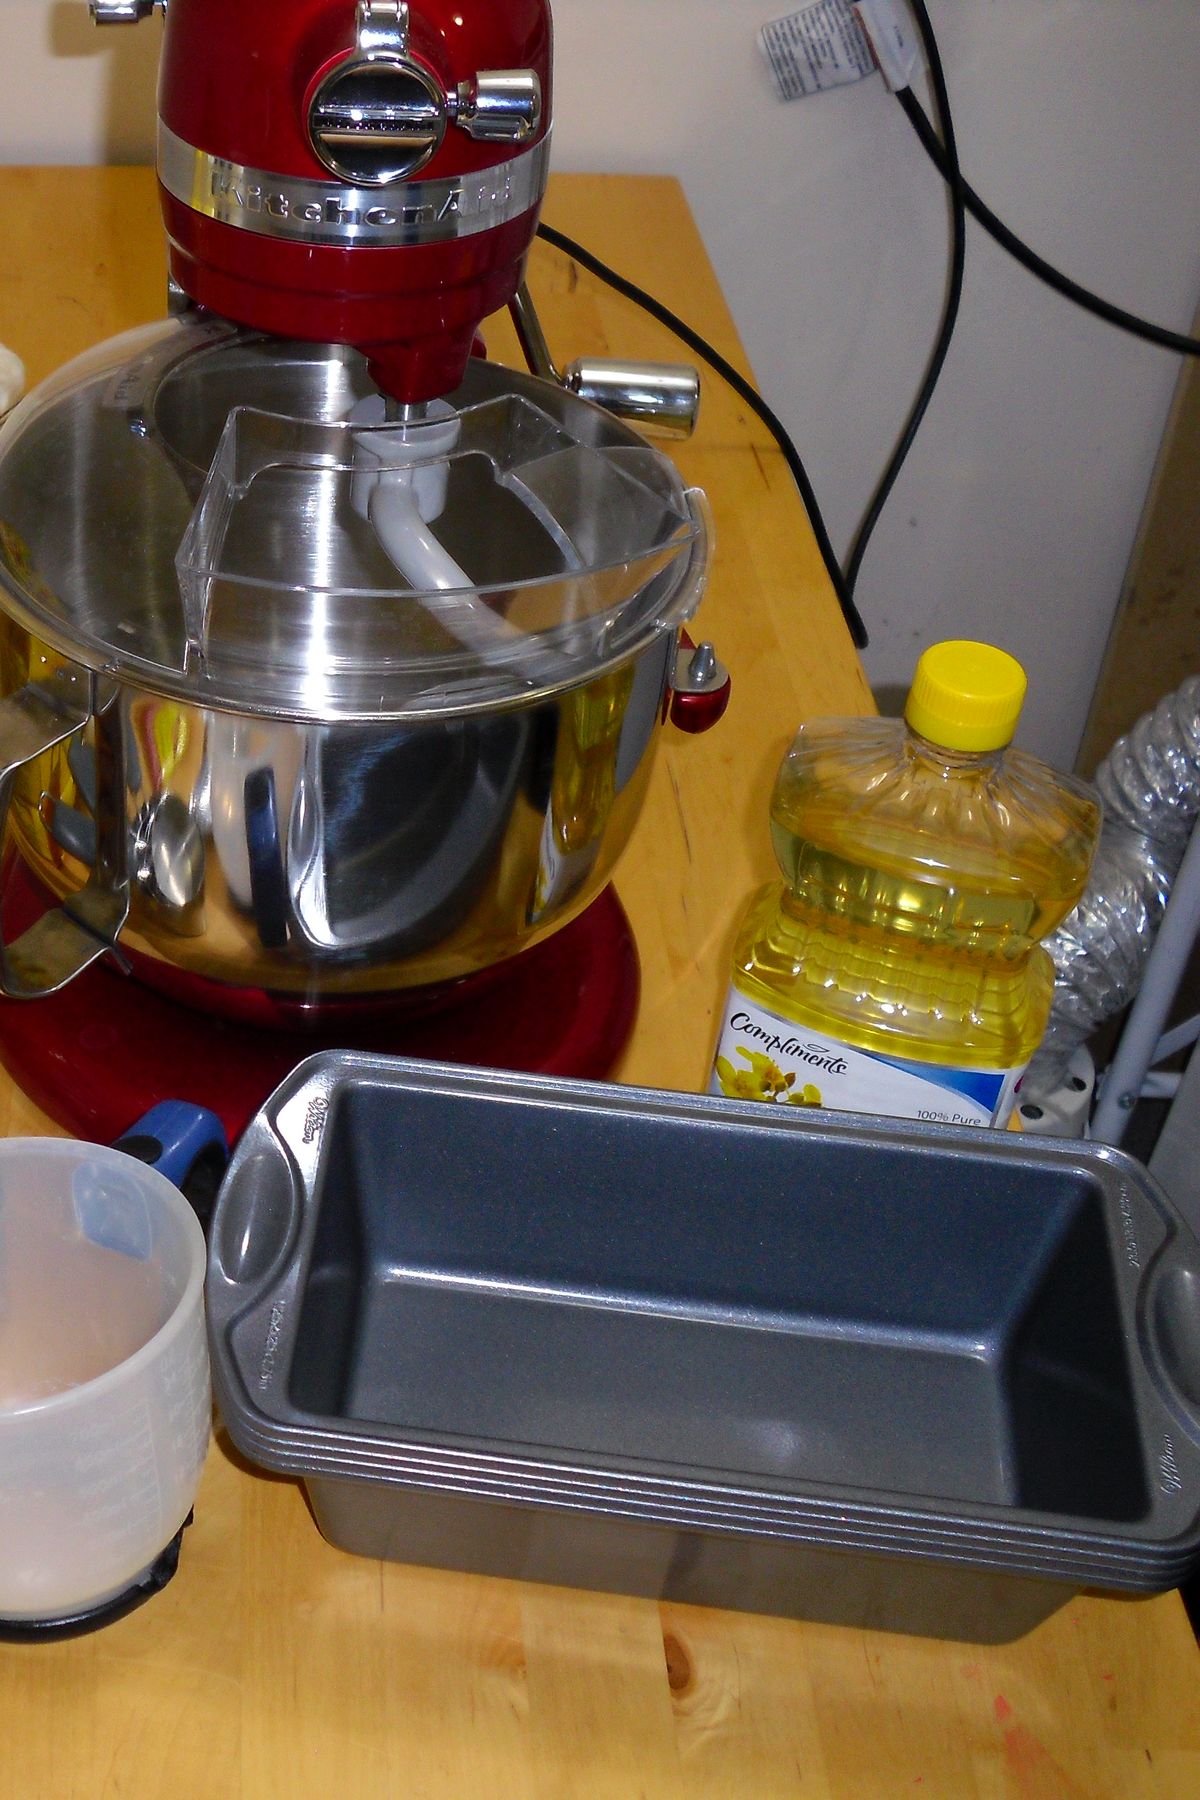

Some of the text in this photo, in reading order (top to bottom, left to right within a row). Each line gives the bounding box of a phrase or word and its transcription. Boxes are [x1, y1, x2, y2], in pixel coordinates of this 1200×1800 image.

[209, 168, 515, 226] KitchenAid
[729, 1011, 850, 1077] Compliments
[916, 1109, 982, 1128] 100% Pure
